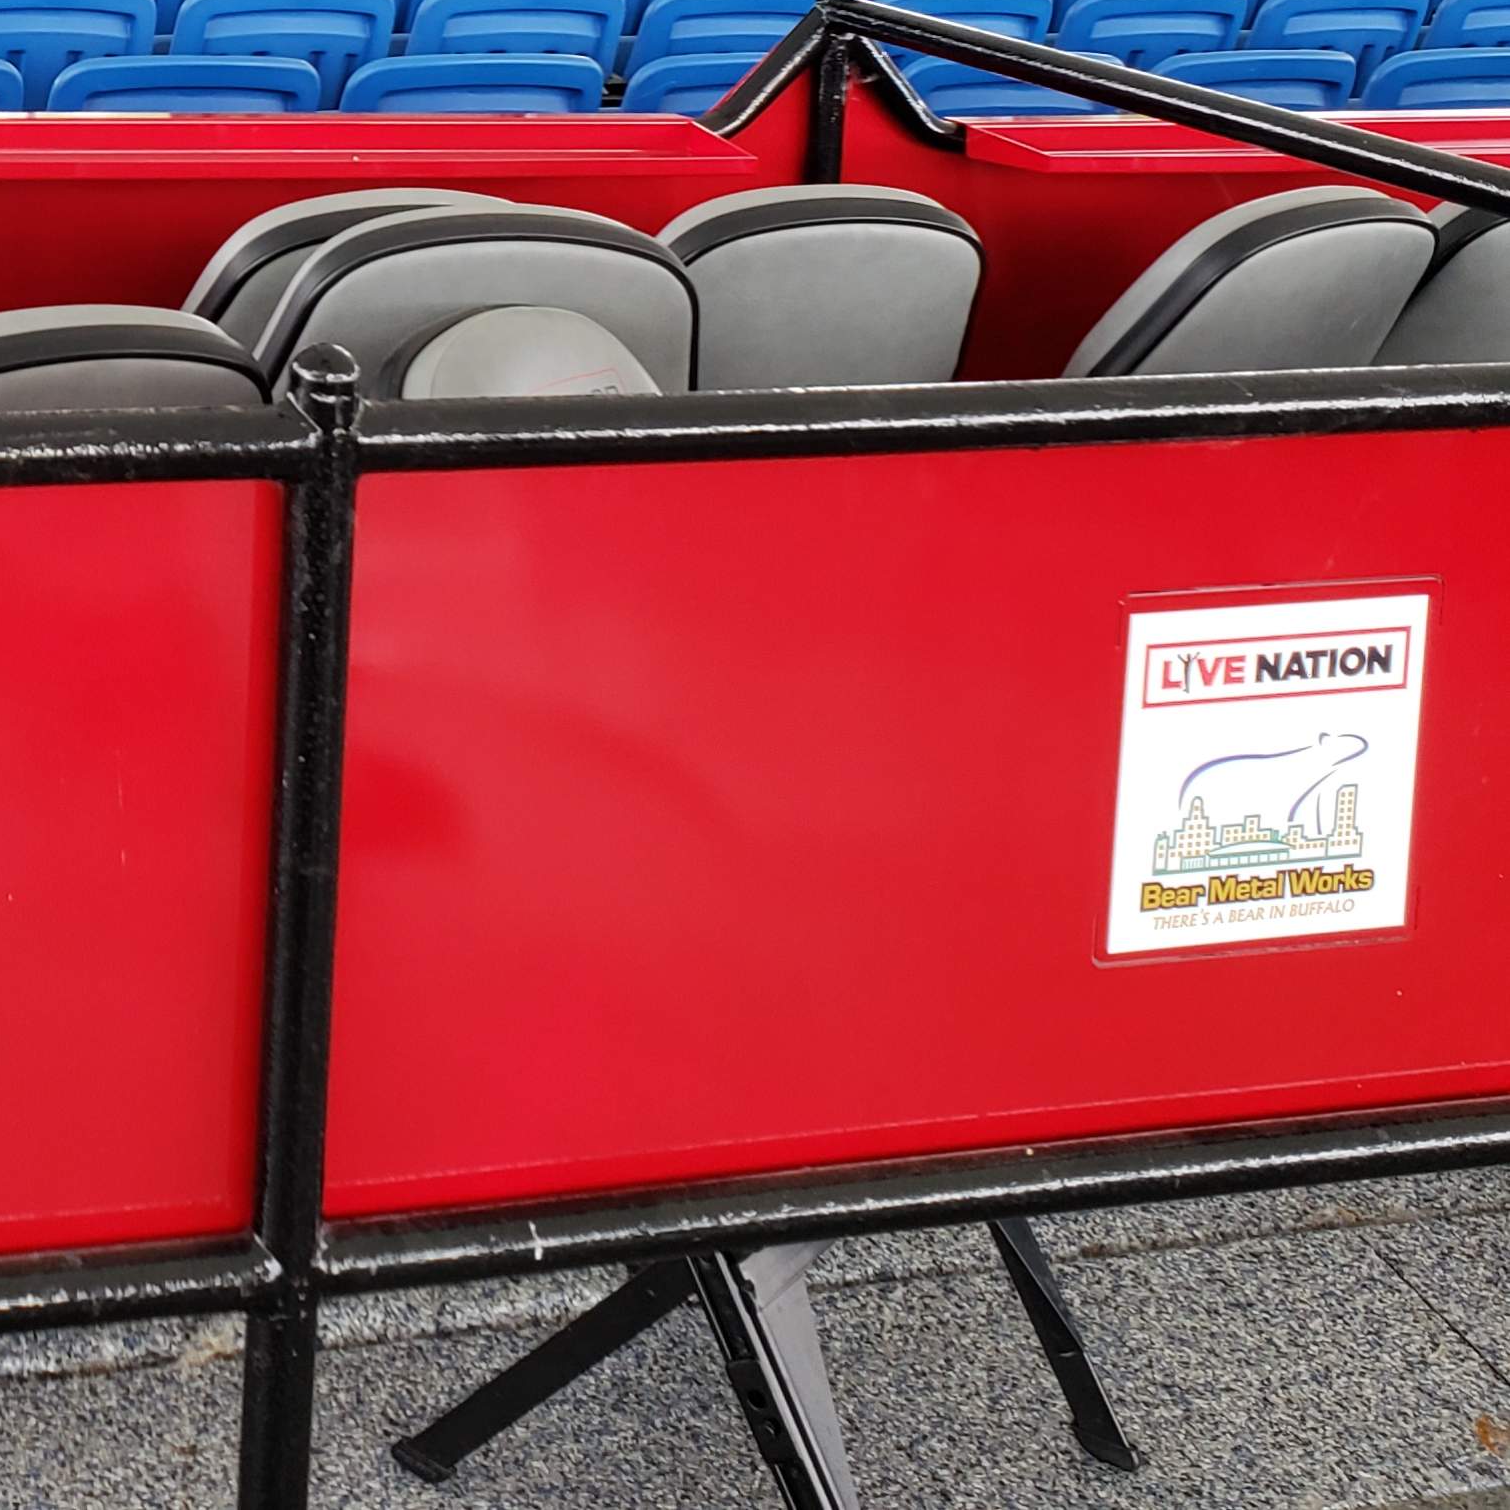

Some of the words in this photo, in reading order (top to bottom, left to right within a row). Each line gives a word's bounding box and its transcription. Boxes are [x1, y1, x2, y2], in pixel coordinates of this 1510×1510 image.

[1160, 651, 1247, 693] LIVE
[1254, 644, 1393, 684] NATION
[1140, 881, 1206, 913] Bear
[1207, 870, 1287, 905] Metal
[1288, 863, 1375, 898] Works
[1152, 908, 1211, 930] THERE'S
[1212, 911, 1225, 925] A
[1227, 907, 1265, 924] BEAR
[1268, 905, 1286, 919] IN
[1289, 898, 1356, 918] BUFFALO
